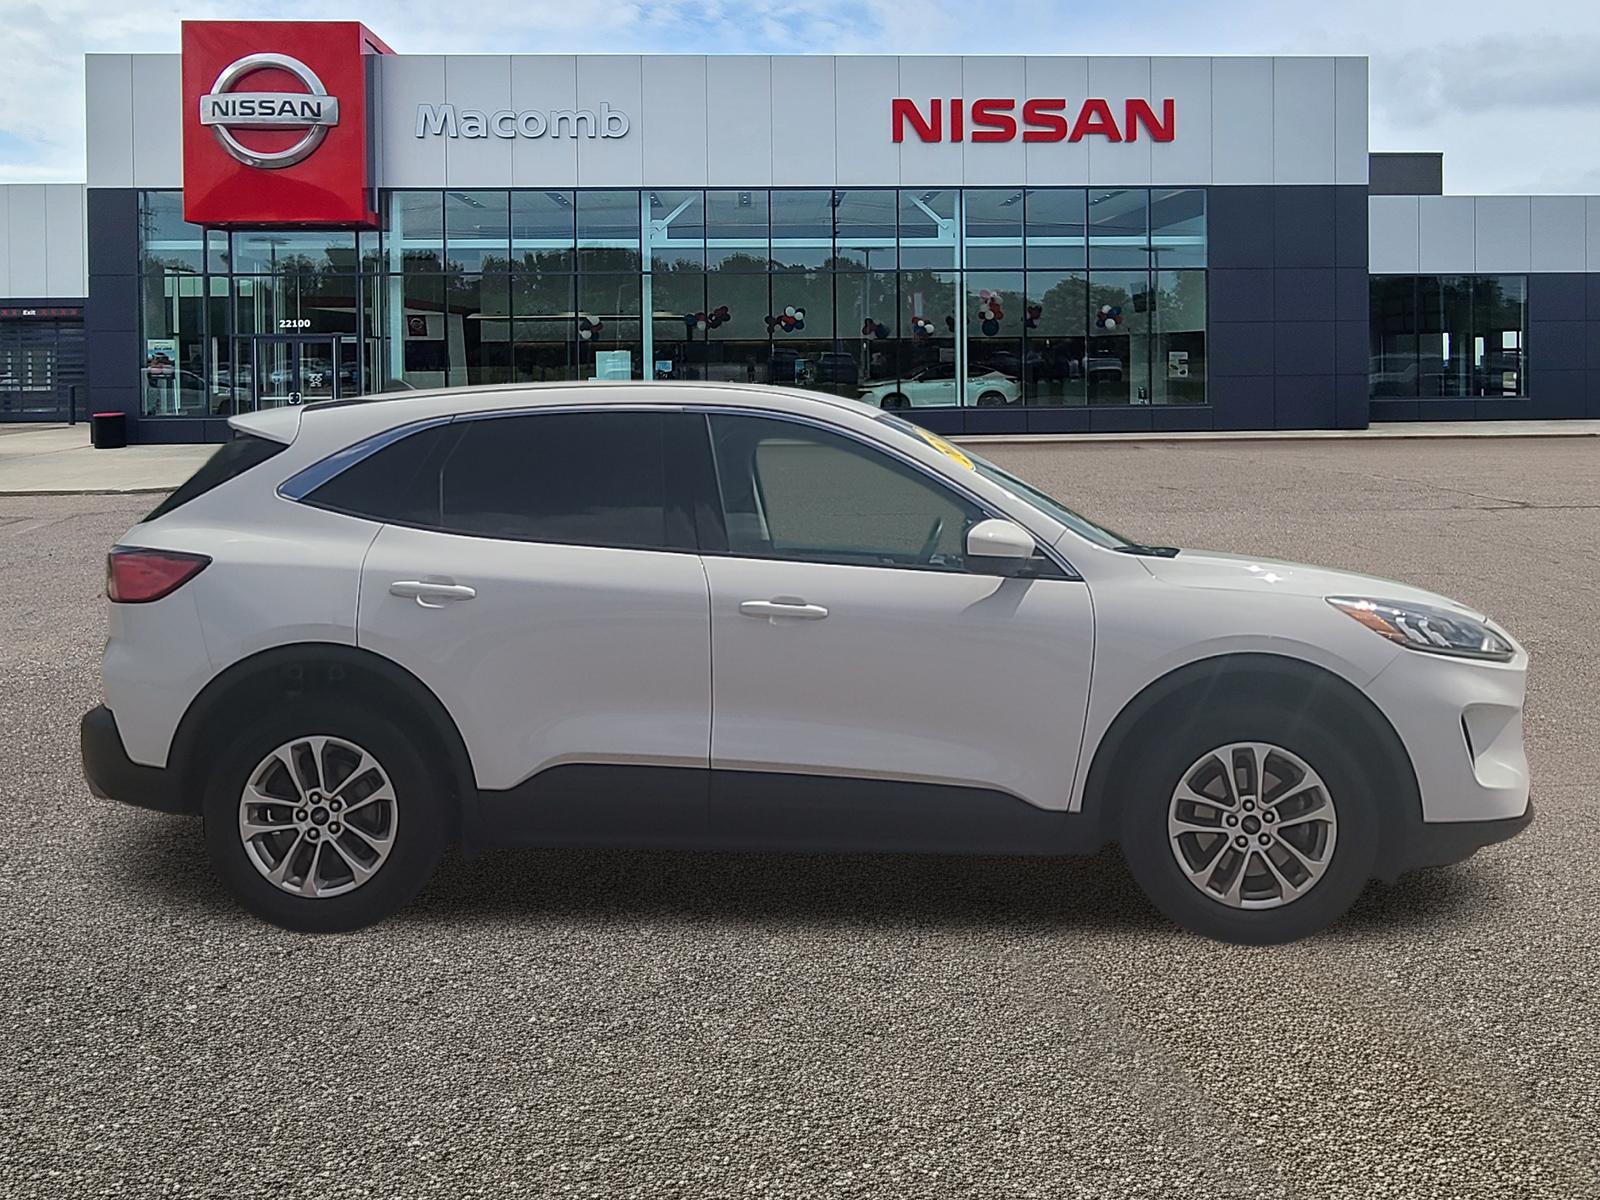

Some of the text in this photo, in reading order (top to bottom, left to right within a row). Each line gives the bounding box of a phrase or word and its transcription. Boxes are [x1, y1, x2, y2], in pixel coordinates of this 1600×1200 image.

[211, 100, 322, 117] NISSAN
[415, 101, 630, 138] Macomb
[892, 98, 1176, 143] NISSAN
[279, 319, 311, 328] 22100
